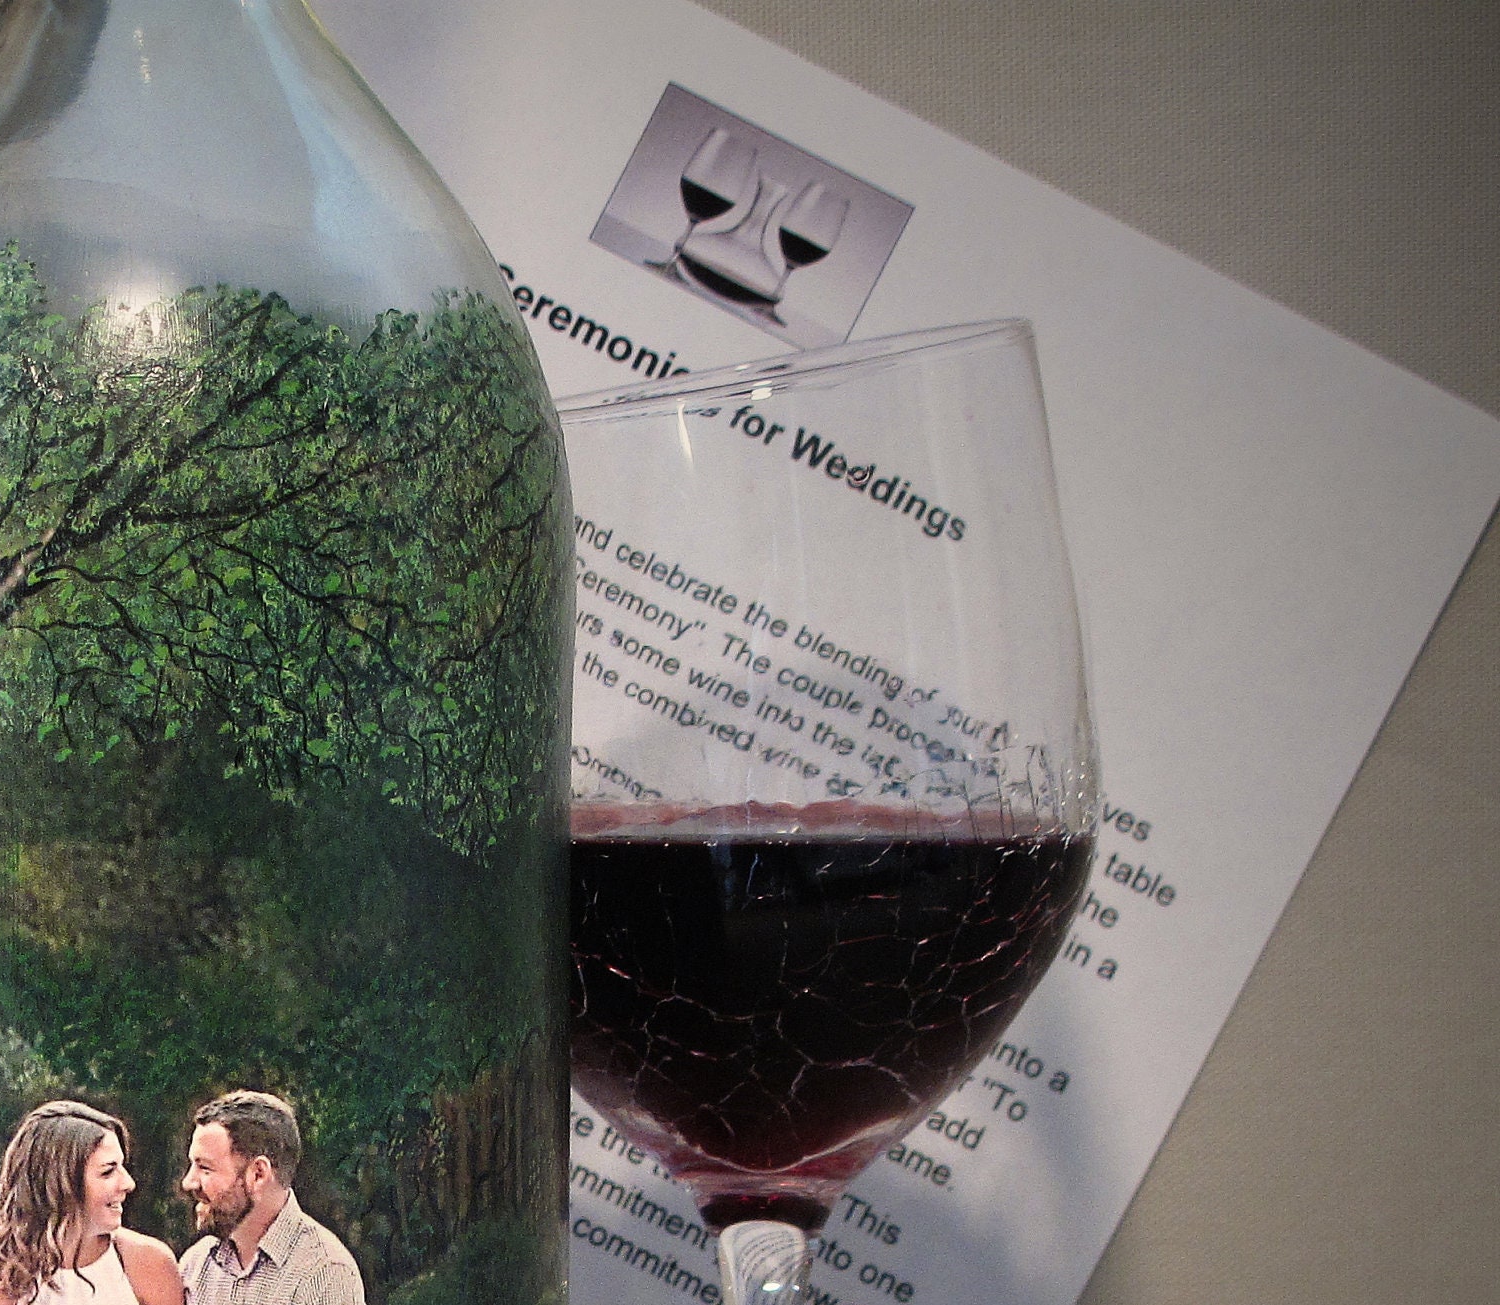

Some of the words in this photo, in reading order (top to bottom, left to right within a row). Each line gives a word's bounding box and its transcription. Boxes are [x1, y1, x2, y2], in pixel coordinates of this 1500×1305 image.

[731, 405, 784, 447] for
[791, 428, 966, 541] Weddings
[616, 543, 738, 614] celebrate
[742, 601, 789, 638] the
[794, 624, 904, 700] blending
[610, 628, 680, 676] some
[688, 667, 751, 709] wine
[756, 695, 805, 732] into
[812, 720, 856, 756] the
[581, 651, 619, 687] the
[1097, 957, 1119, 981] a
[723, 633, 772, 674] The
[776, 666, 863, 714] couple
[1104, 853, 1177, 907] table
[926, 1110, 986, 1151] add
[1049, 1070, 1071, 1094] a
[841, 1194, 902, 1246] This
[859, 1263, 917, 1305] one
